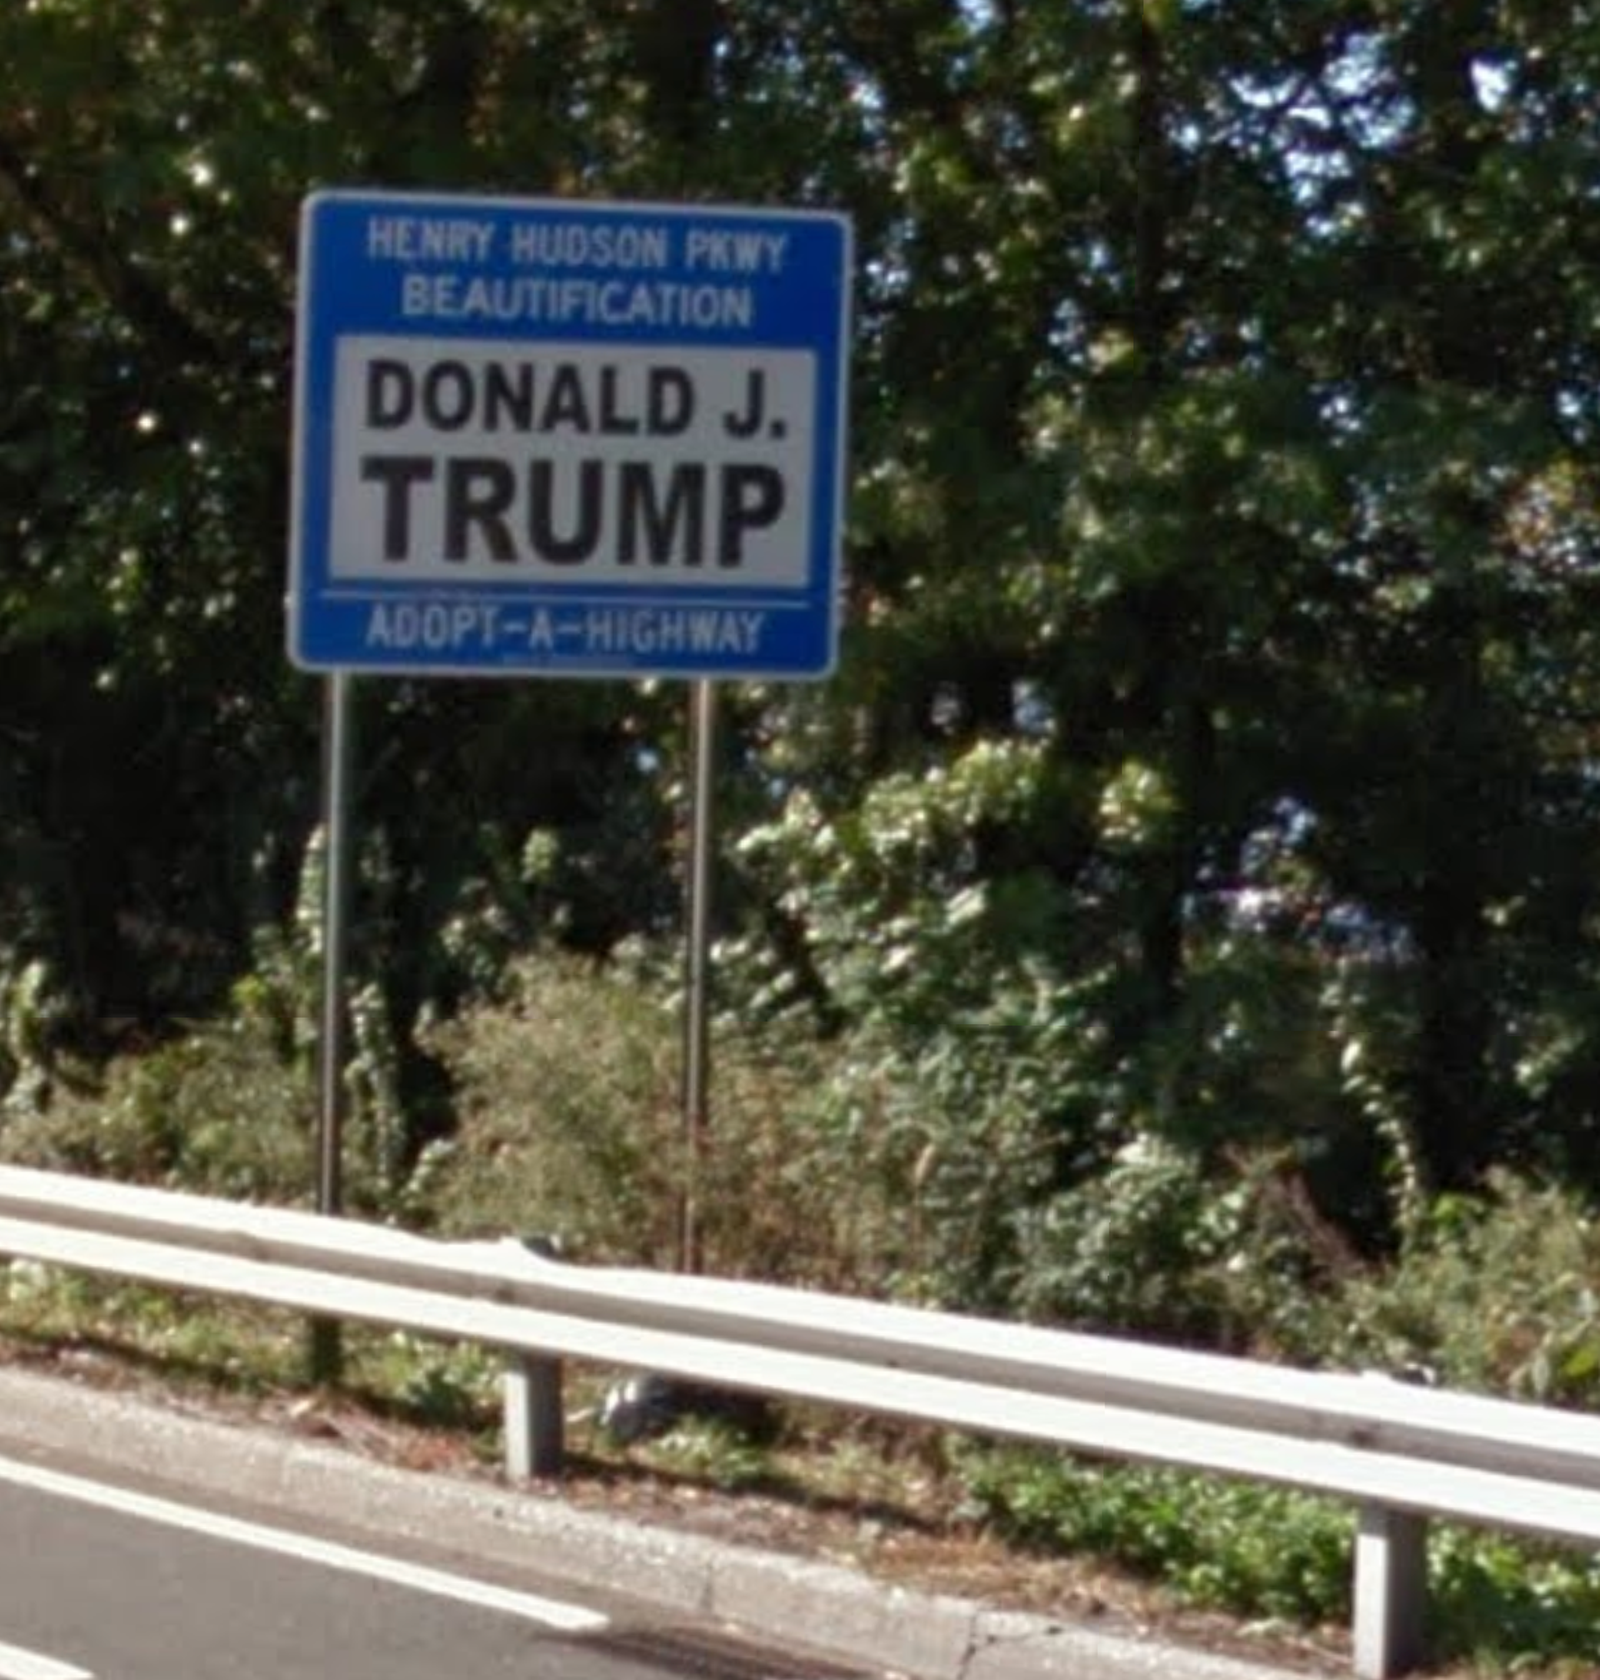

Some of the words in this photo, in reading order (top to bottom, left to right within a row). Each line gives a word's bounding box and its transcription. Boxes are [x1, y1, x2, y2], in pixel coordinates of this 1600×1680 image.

[366, 214, 495, 264] HENRY
[510, 221, 668, 268] HUDSON
[684, 229, 788, 273] PKWY
[401, 274, 754, 328] BEAUTIFICATION
[366, 358, 695, 438] DONALD
[721, 369, 788, 441] J.
[360, 454, 788, 569] TRUMP
[365, 604, 767, 653] ADOPT-A-HIGHWAY
